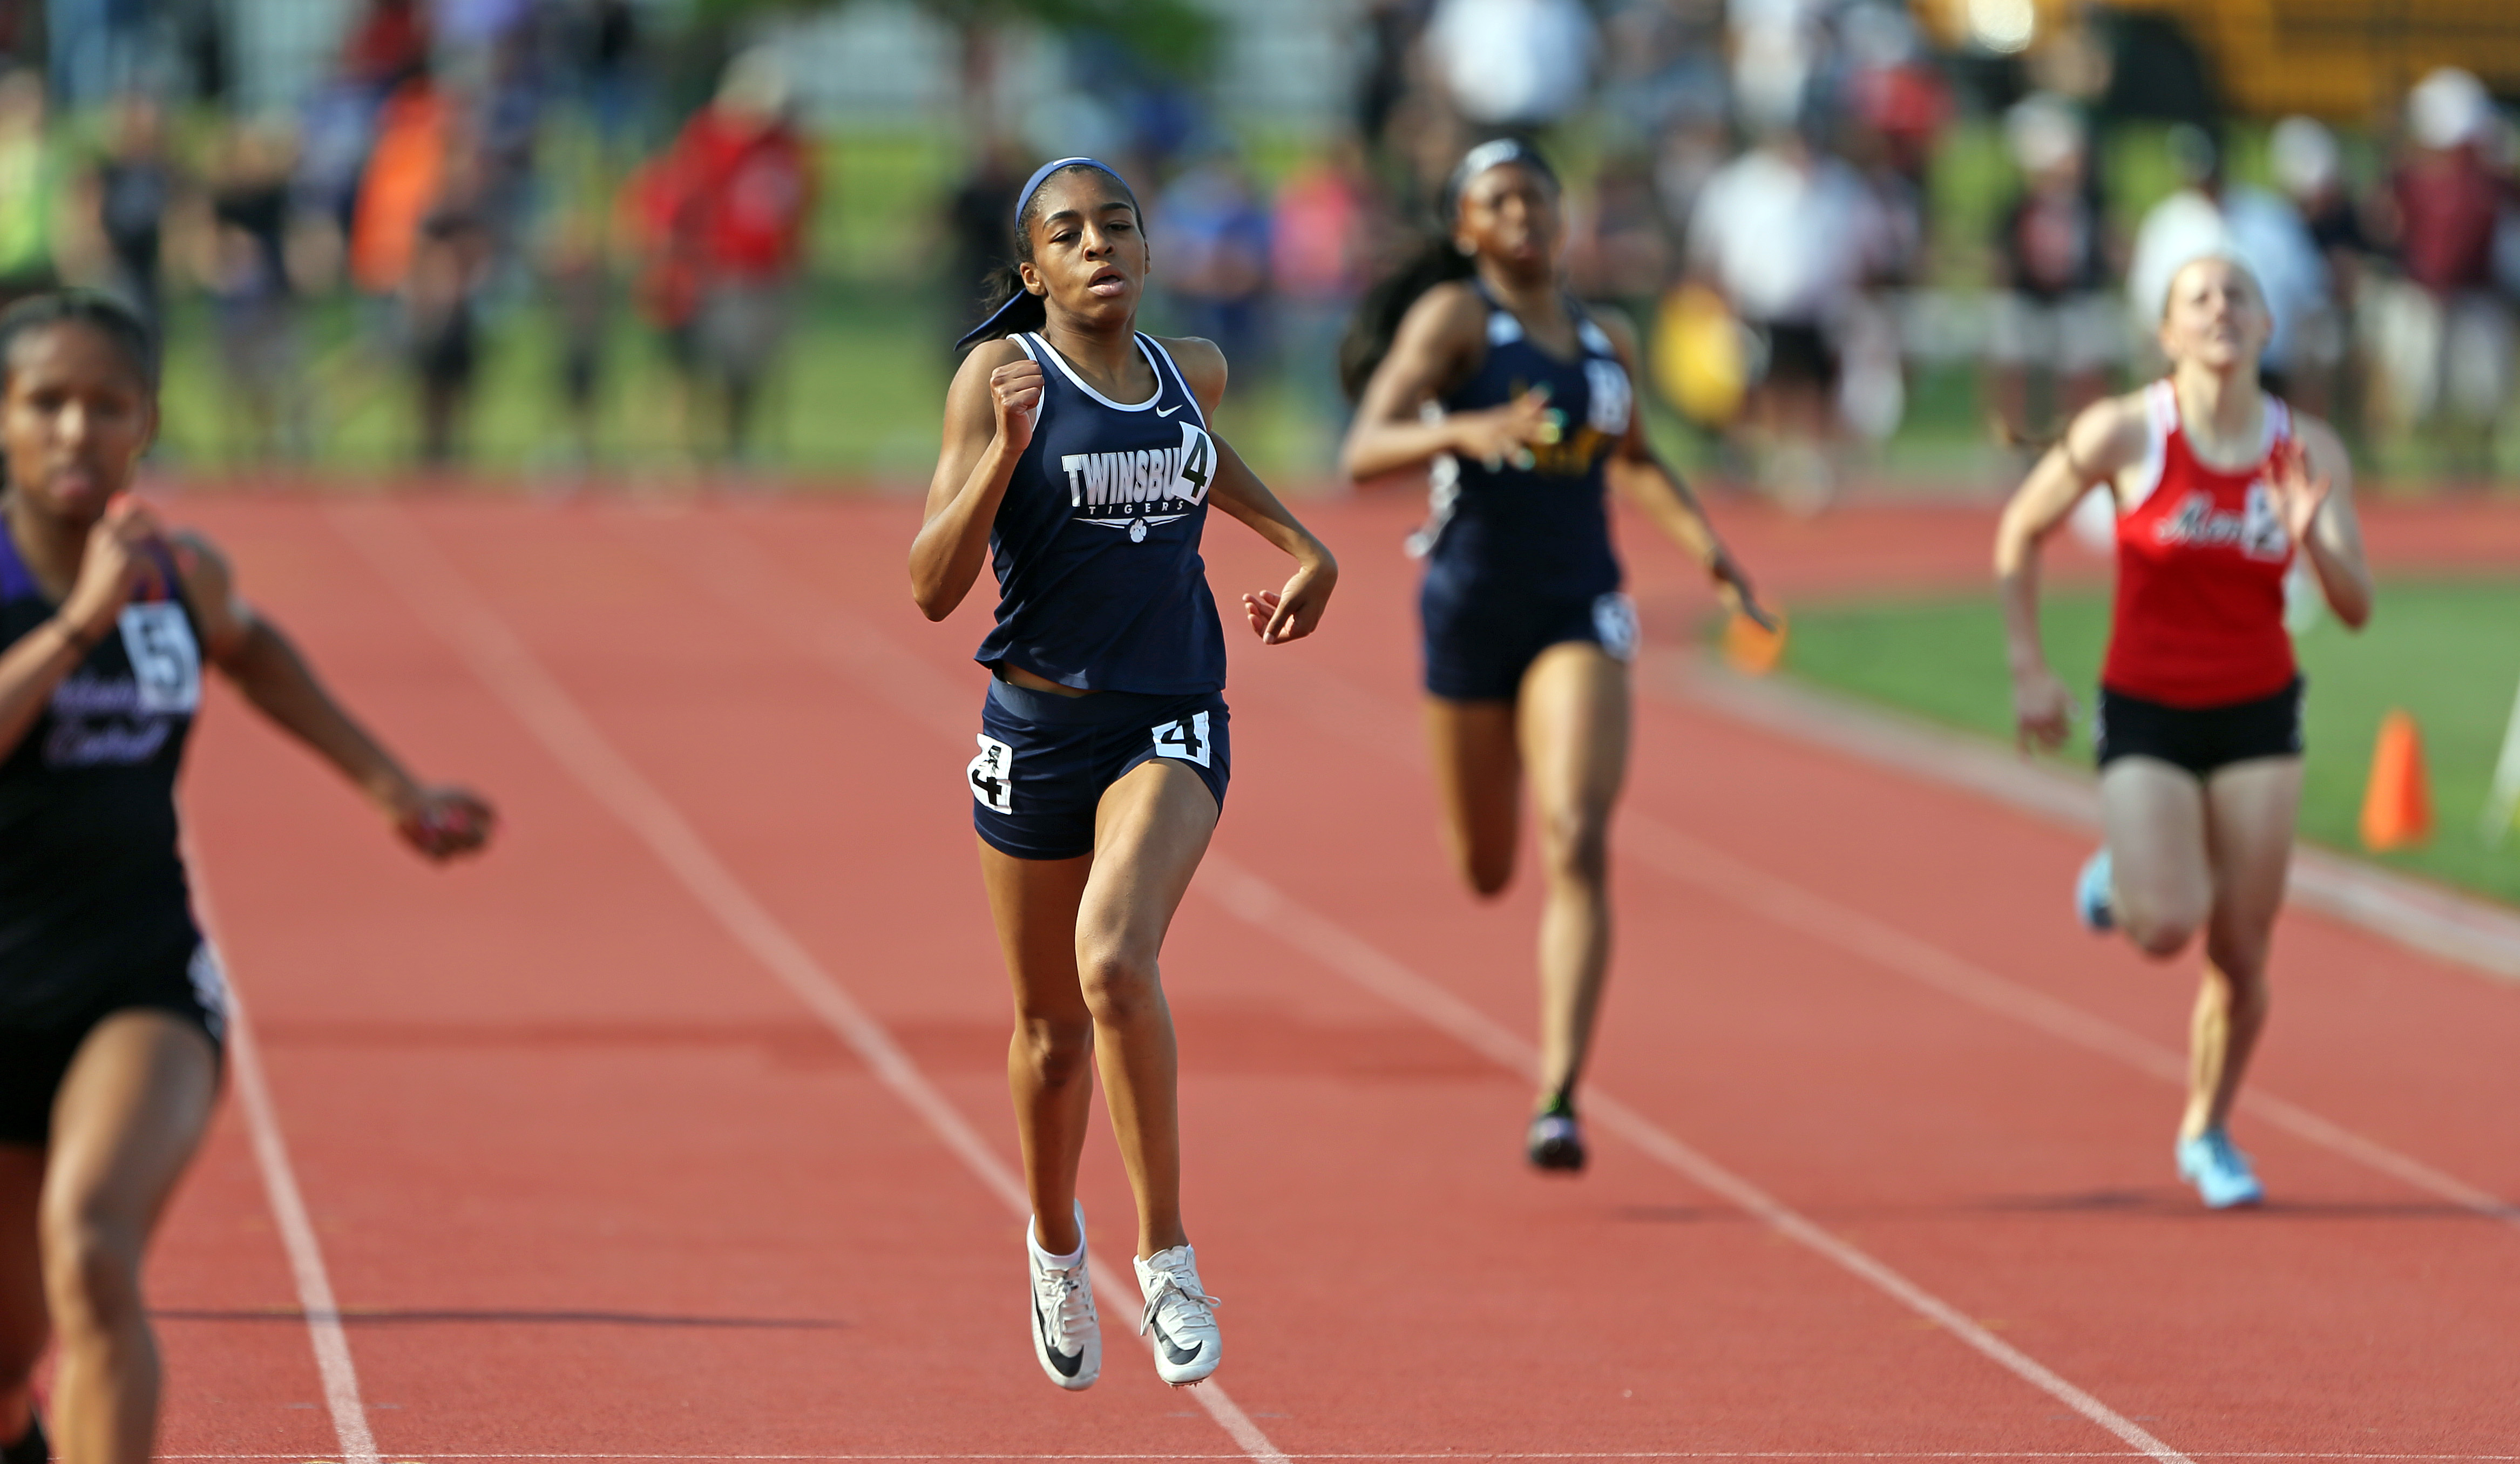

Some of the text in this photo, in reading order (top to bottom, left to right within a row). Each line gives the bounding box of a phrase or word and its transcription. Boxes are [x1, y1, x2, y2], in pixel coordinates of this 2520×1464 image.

[1061, 447, 1182, 507] TWINSBU
[1181, 431, 1208, 499] 4
[1089, 500, 1184, 515] TIGERS
[138, 615, 188, 699] 5
[1160, 716, 1202, 758] 4
